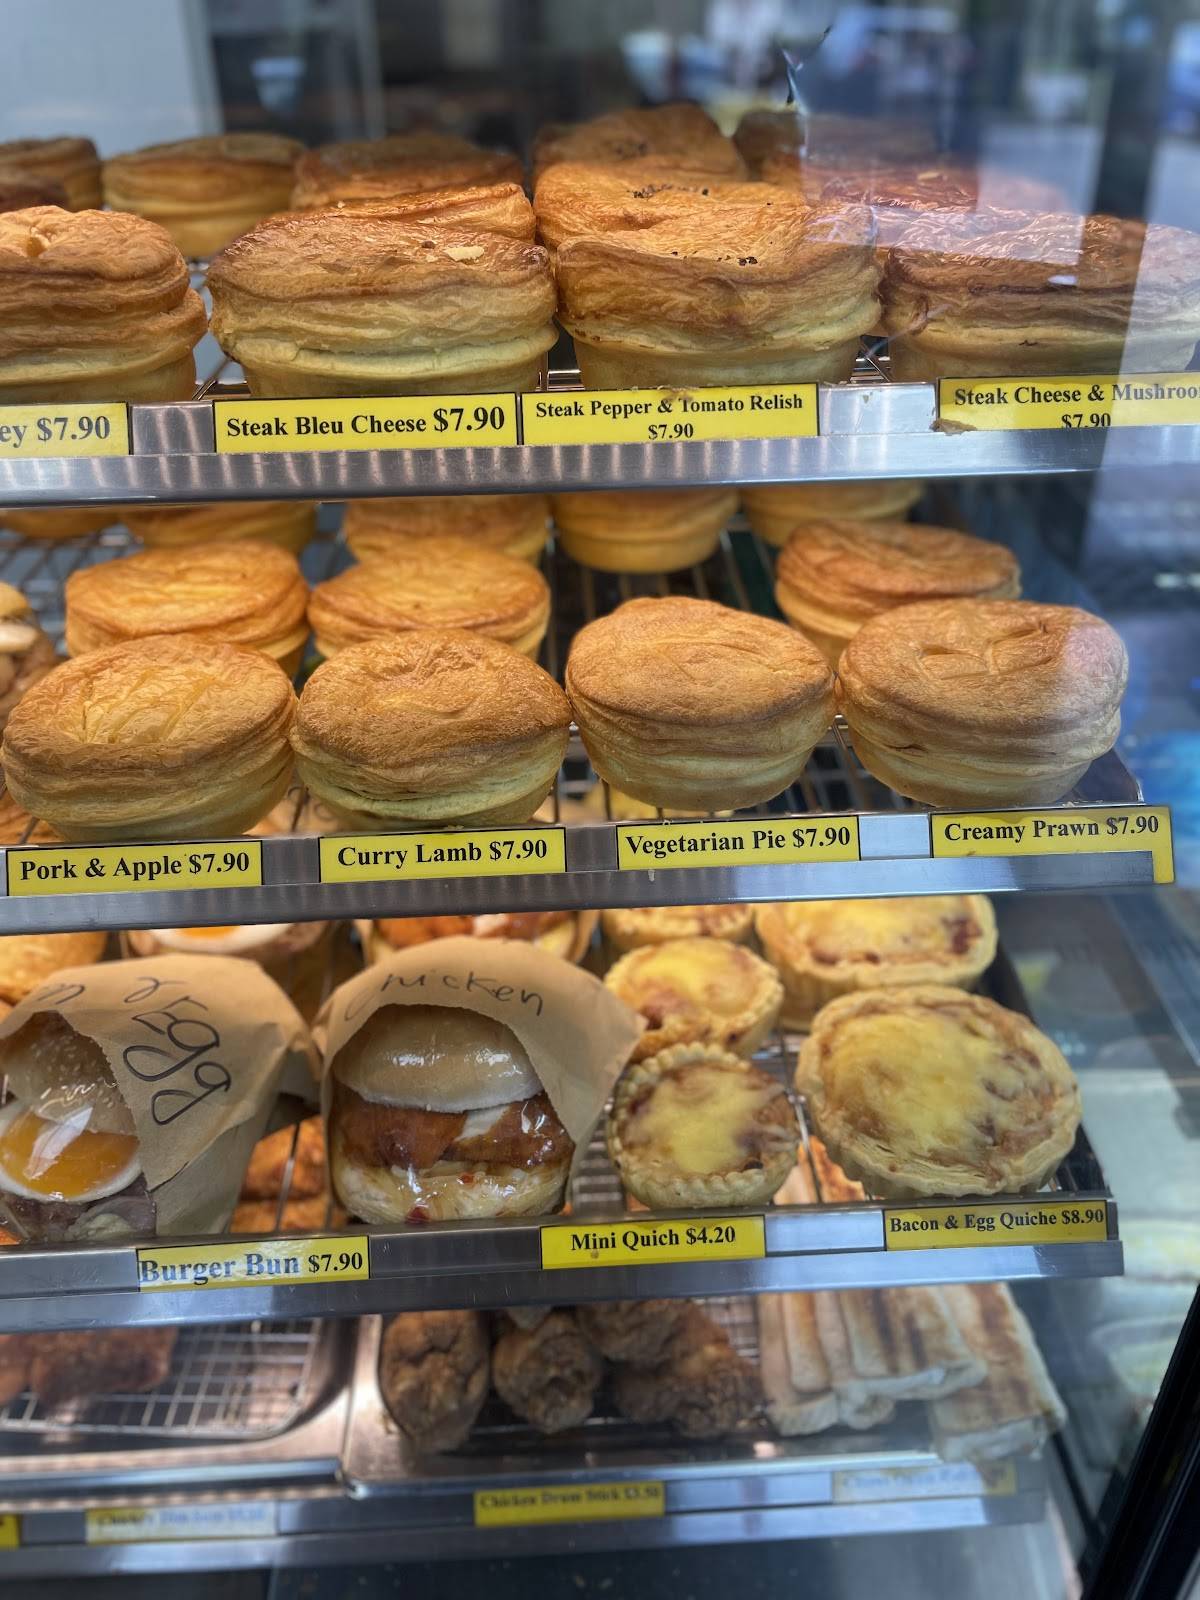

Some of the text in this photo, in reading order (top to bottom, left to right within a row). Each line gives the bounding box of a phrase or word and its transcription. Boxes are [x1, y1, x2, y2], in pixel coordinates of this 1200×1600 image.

[536, 394, 803, 419] Steak Pepper & Tomato Relish
[955, 383, 1200, 406] Steak Cheese & Mushroo
[37, 415, 110, 443] $7.90
[227, 406, 505, 437] Steak Bleu Cheese $7.90
[648, 423, 694, 440] $7.90
[1061, 412, 1111, 430] $7.90
[625, 826, 851, 859] Vegetarian Pie $7.90
[944, 815, 1159, 843] Creamy Prawn $7.90
[20, 852, 249, 881] Pork & Apple $7.90
[338, 839, 548, 869] Curry Lamb $7.90
[890, 1208, 1104, 1233] Bacon & Egg Quiche $8.90
[571, 1226, 736, 1251] Mini Quich $4.20
[138, 1252, 363, 1286] Burger Bun $7.90
